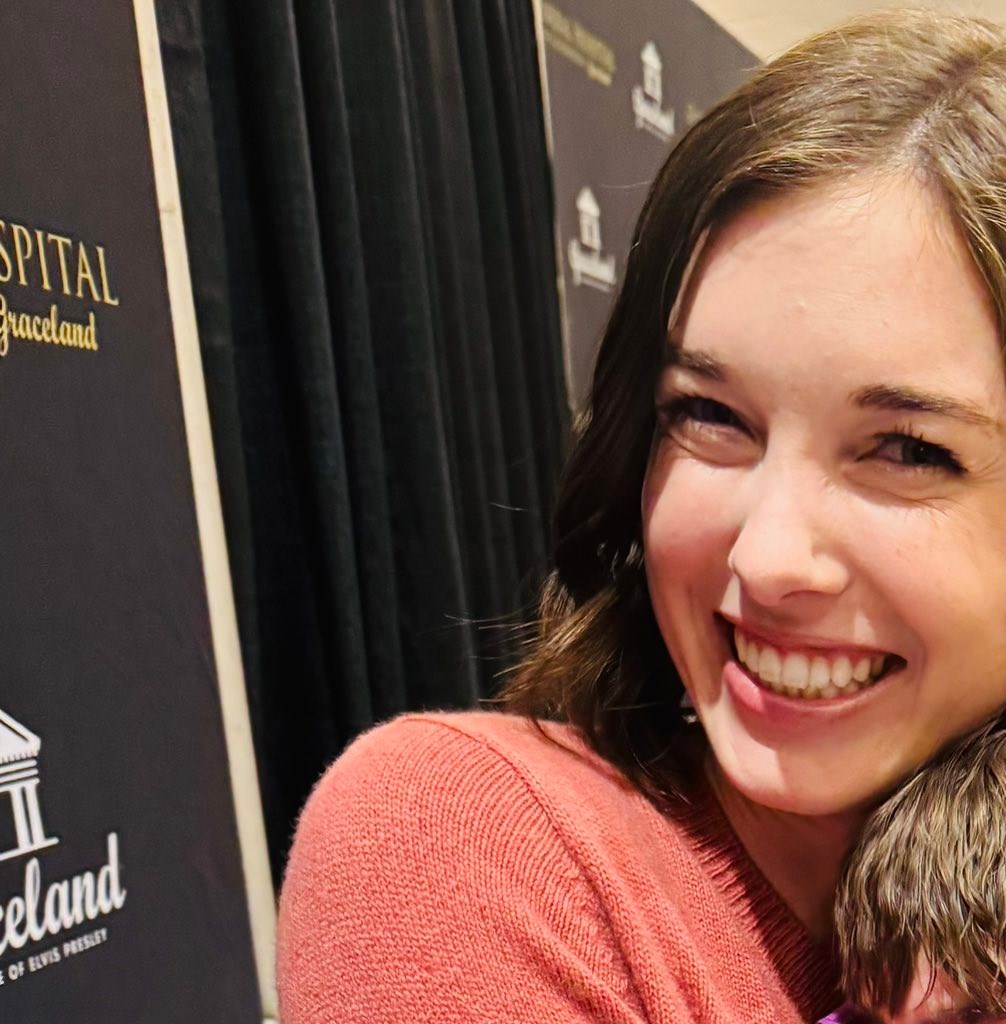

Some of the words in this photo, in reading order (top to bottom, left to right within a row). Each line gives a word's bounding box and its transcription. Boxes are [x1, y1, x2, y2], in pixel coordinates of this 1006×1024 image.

[0, 831, 127, 957] eland
[8, 961, 25, 981] OF
[28, 946, 61, 973] ELVIS
[63, 928, 108, 958] PRESLEY
